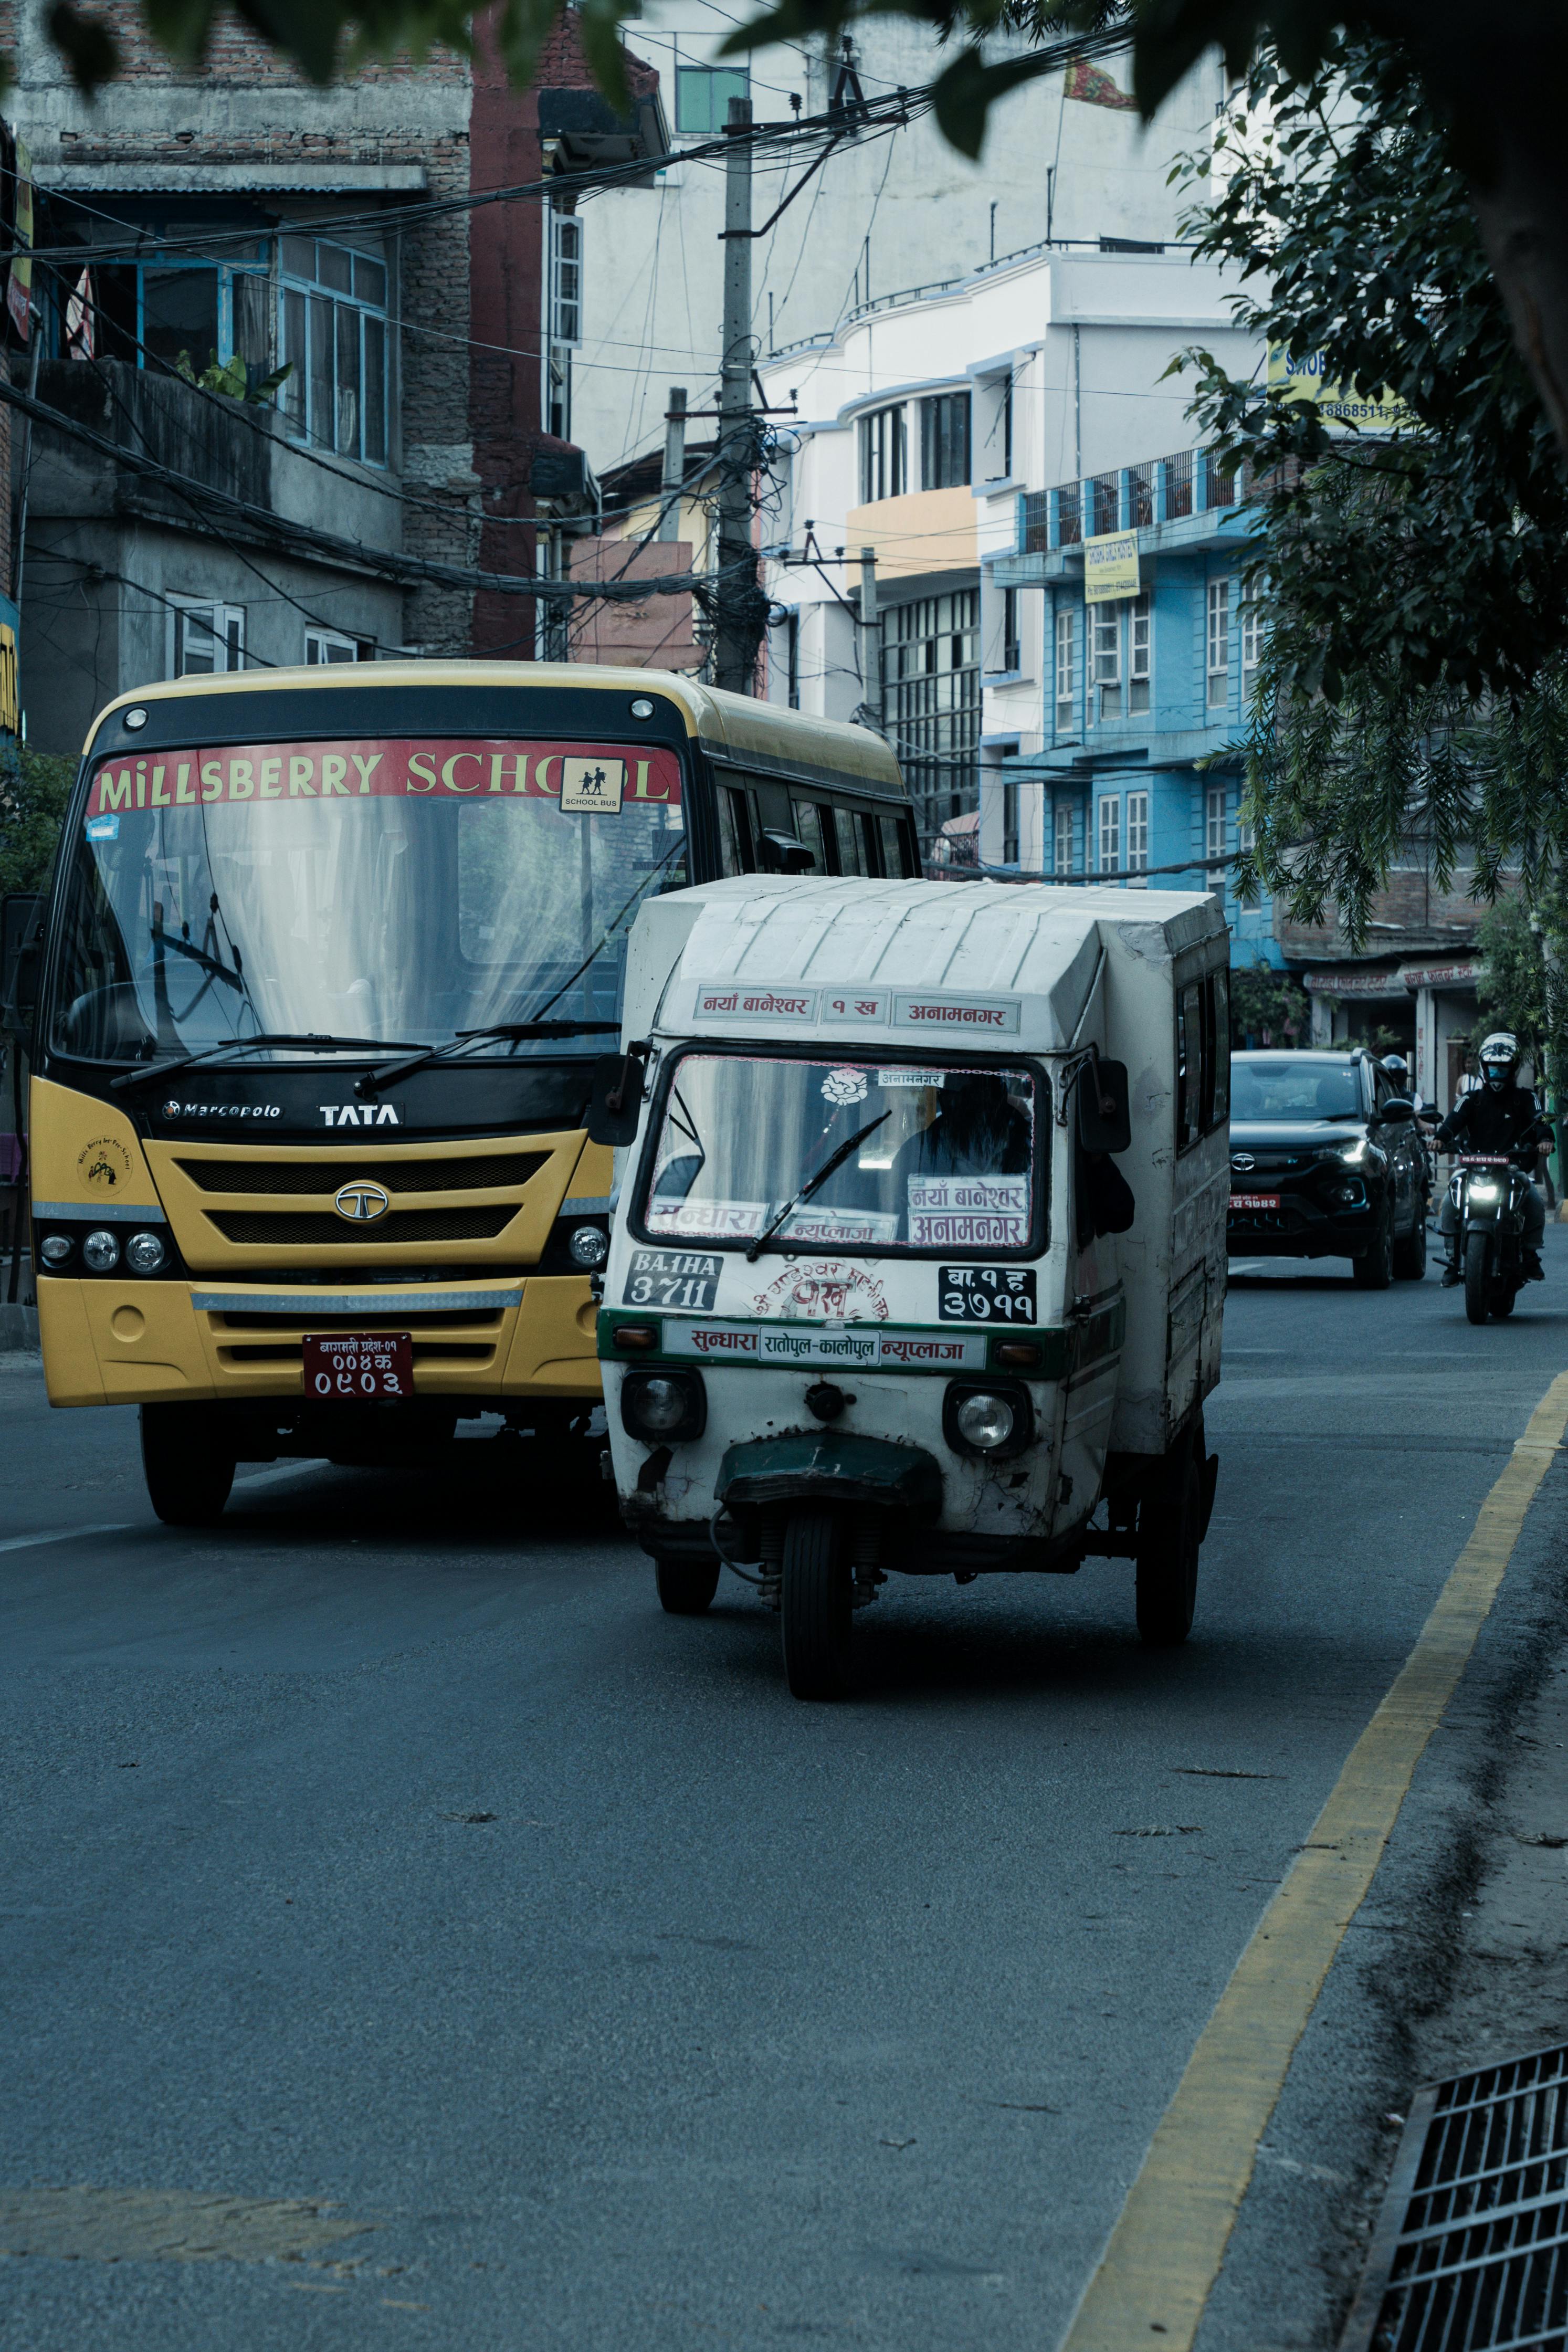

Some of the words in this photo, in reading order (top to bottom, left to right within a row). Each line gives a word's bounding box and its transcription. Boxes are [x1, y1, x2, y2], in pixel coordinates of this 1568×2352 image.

[406, 752, 670, 800] SCHOL
[703, 992, 739, 1011] नयाँ
[743, 993, 810, 1014] बानेश्वर
[832, 1000, 845, 1014] १
[854, 1001, 879, 1015] ख
[908, 1005, 1006, 1026] अनामनगर
[882, 1074, 942, 1086] अनामनगर
[184, 1104, 280, 1118] Marcopolo
[319, 1104, 399, 1126] TATA
[912, 1180, 949, 1206] नयाँ
[955, 1182, 1024, 1209] बानेश्वर
[912, 1215, 1024, 1243] अनामनगर
[631, 1276, 708, 1307] 3711
[944, 1292, 1033, 1321] ३७११
[320, 1337, 359, 1355] बागमती
[691, 1330, 759, 1352] सुन्धारा
[881, 1340, 965, 1362] न्यूप्लाजा
